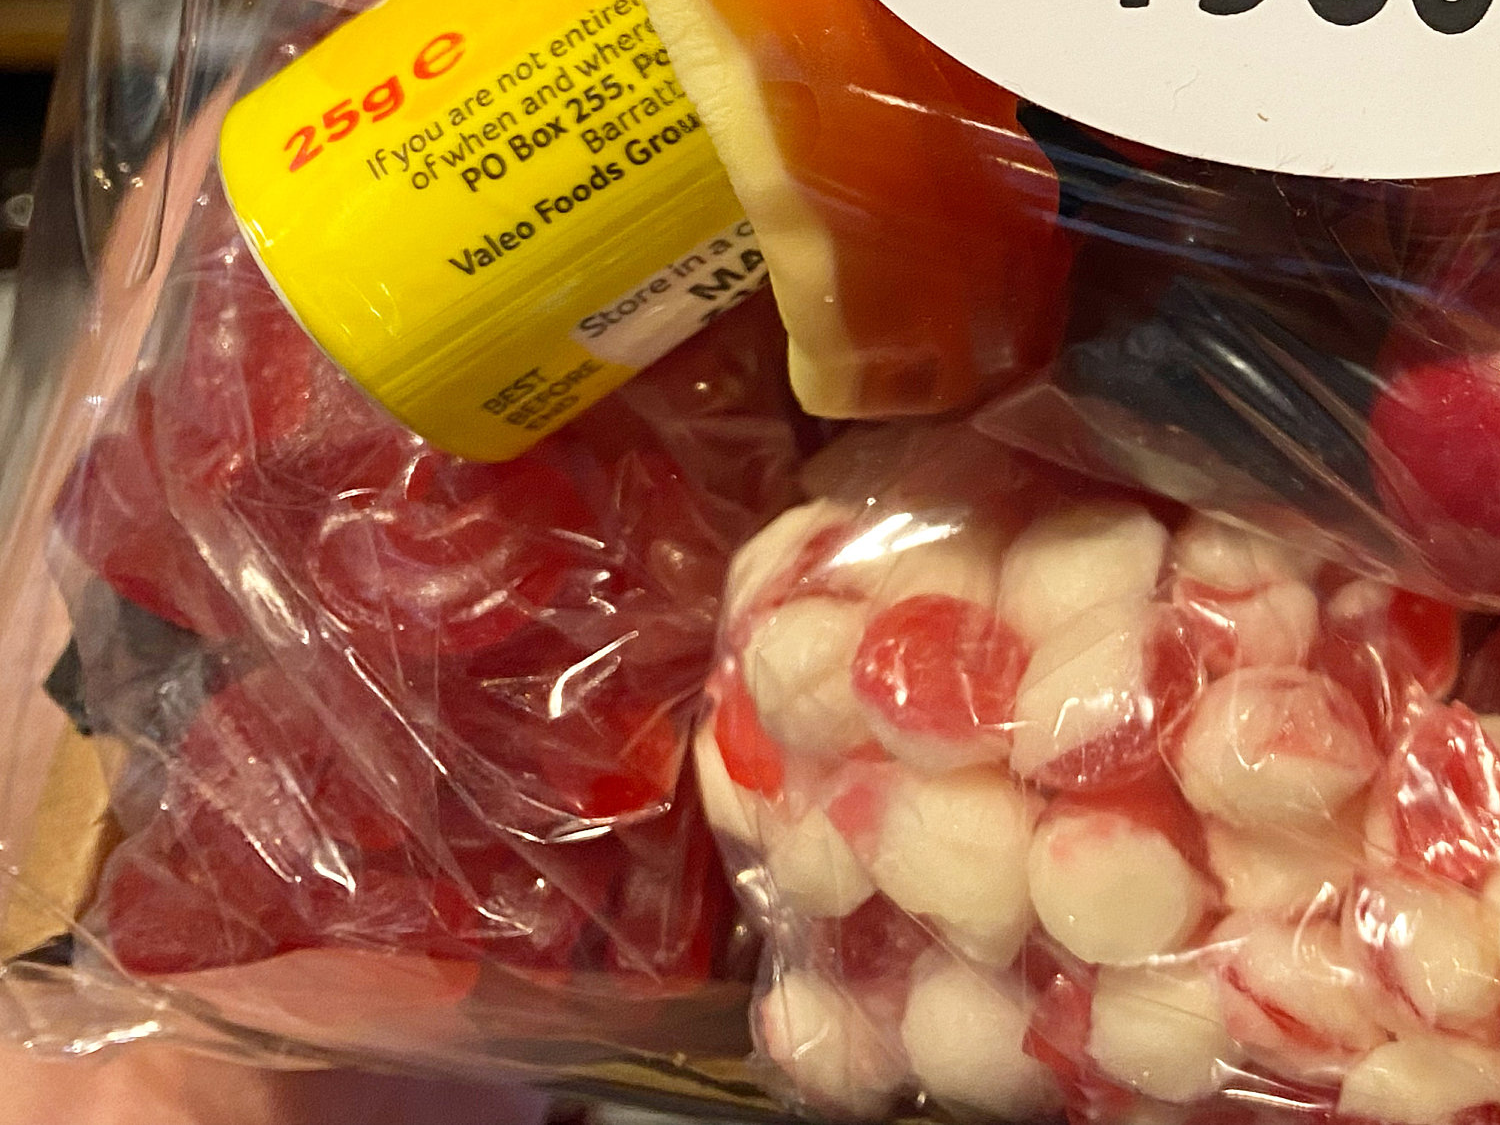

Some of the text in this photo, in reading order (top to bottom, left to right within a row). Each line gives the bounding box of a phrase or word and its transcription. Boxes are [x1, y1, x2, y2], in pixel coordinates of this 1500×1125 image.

[283, 75, 405, 174] 25g
[366, 148, 389, 181] If
[391, 120, 444, 172] you
[448, 88, 494, 127] are
[496, 52, 548, 94] not
[411, 153, 440, 190] of
[440, 110, 518, 168] when
[521, 66, 575, 116] and
[461, 152, 508, 193] PO
[508, 116, 569, 163] Box
[564, 73, 636, 125] 255,
[447, 220, 536, 276] Valeo
[533, 161, 626, 225] Foods
[579, 277, 672, 339] Store
[668, 253, 707, 279] in
[708, 238, 733, 256] a
[482, 365, 548, 416] BEST
